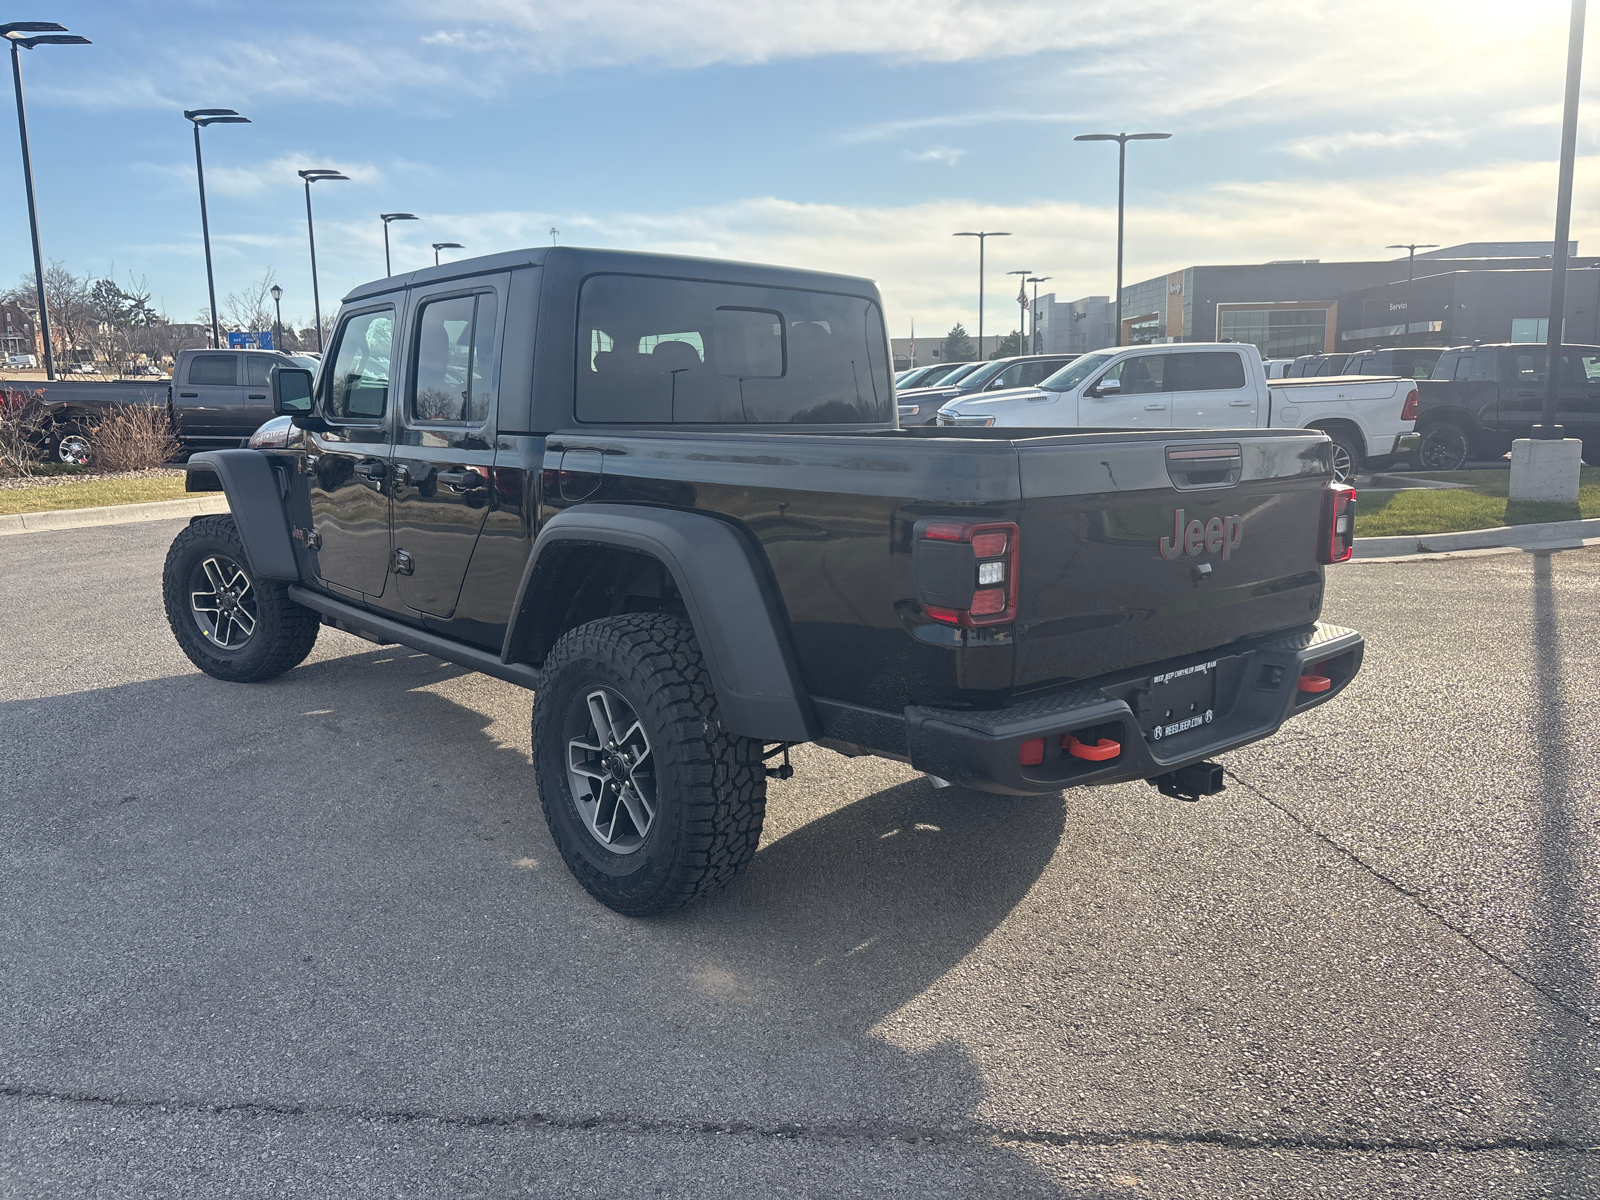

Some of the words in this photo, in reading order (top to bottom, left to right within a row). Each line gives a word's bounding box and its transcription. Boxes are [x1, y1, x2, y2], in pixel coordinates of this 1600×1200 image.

[1160, 509, 1243, 562] Jeep
[1154, 675, 1164, 683] REED
[1164, 672, 1174, 681] JEEP
[1174, 666, 1194, 677] CHRYSLER
[1194, 663, 1207, 672] DODGE
[1207, 660, 1216, 668] RAM
[1165, 716, 1202, 736] REEDJEEP.COM
